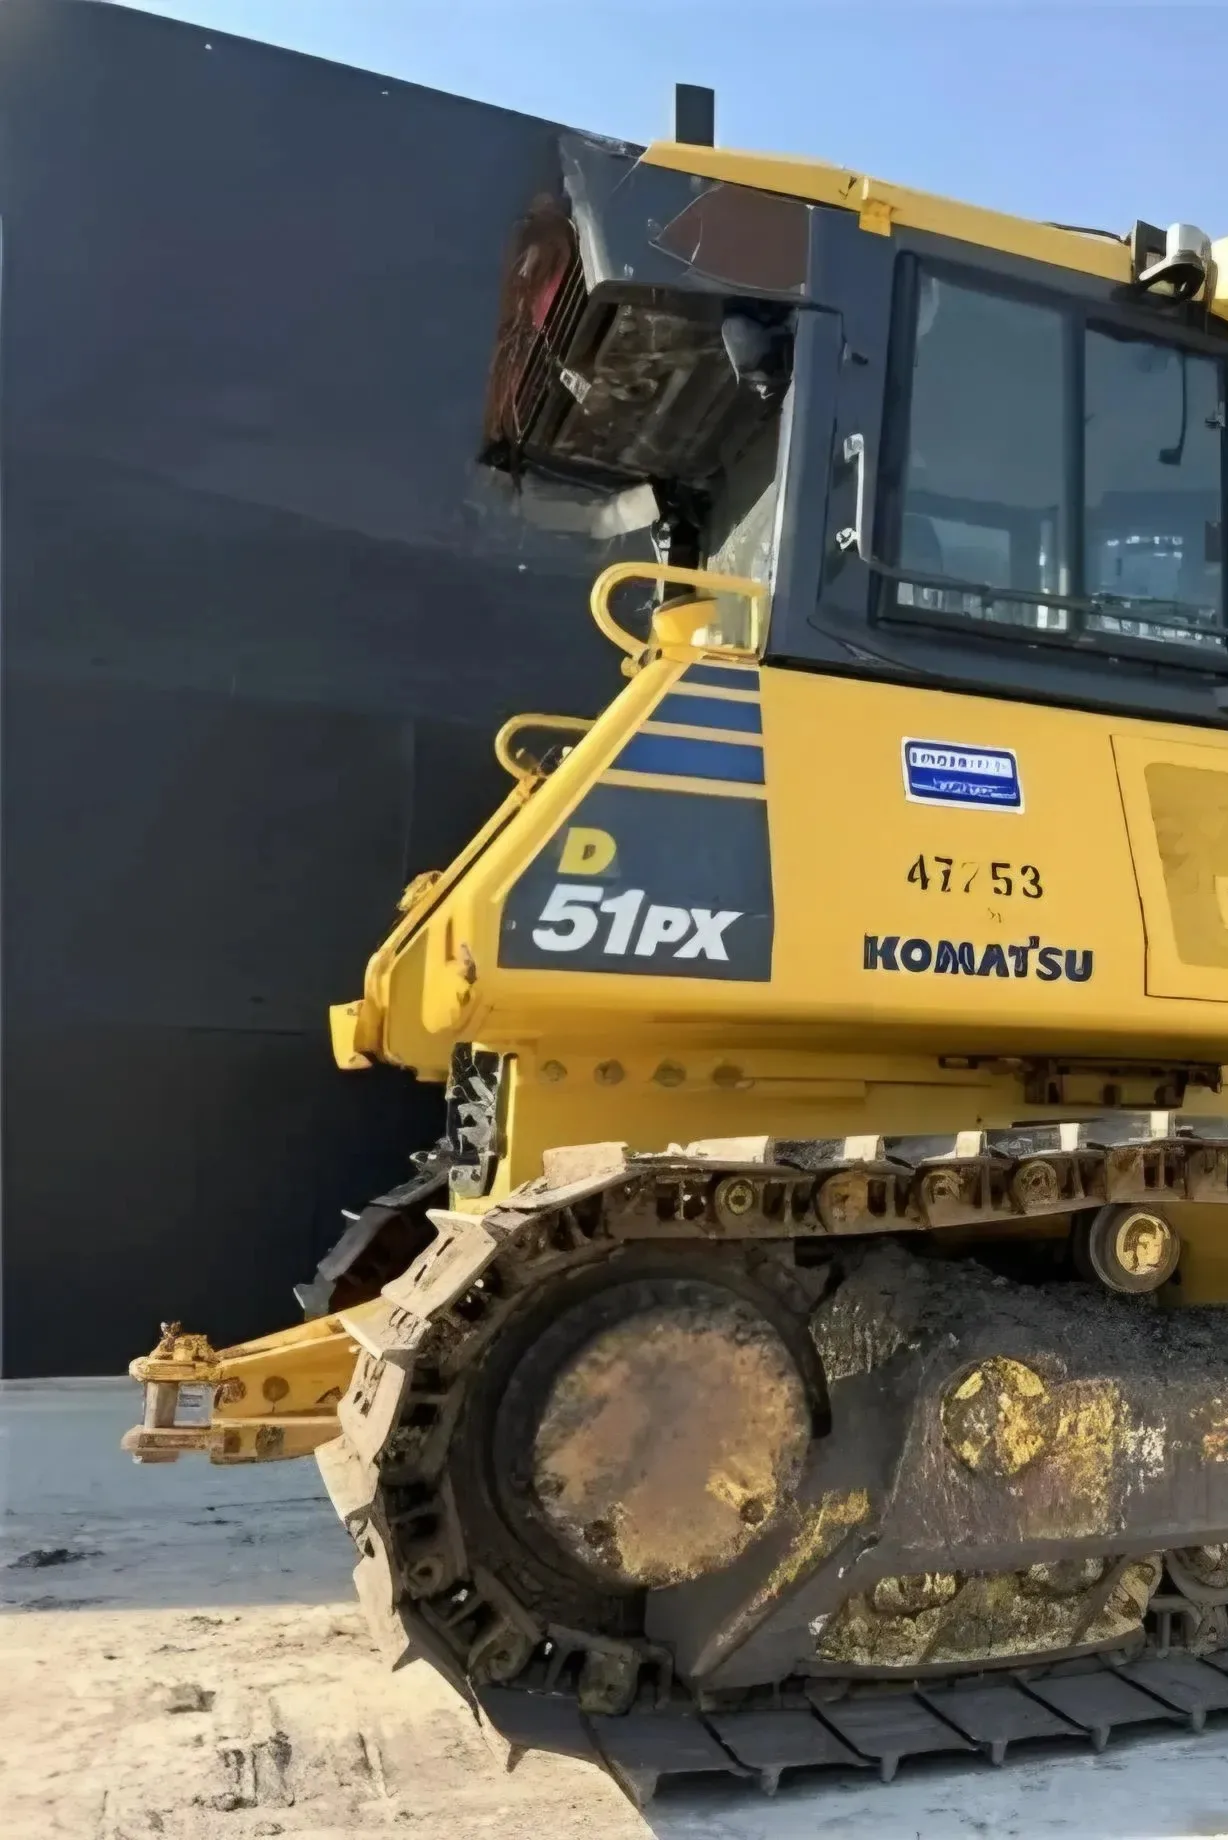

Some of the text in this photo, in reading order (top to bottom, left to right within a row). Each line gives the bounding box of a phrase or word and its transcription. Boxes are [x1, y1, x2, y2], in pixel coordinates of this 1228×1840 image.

[557, 827, 617, 875] D
[532, 883, 744, 961] 51PX
[863, 934, 1094, 982] KOMATSU
